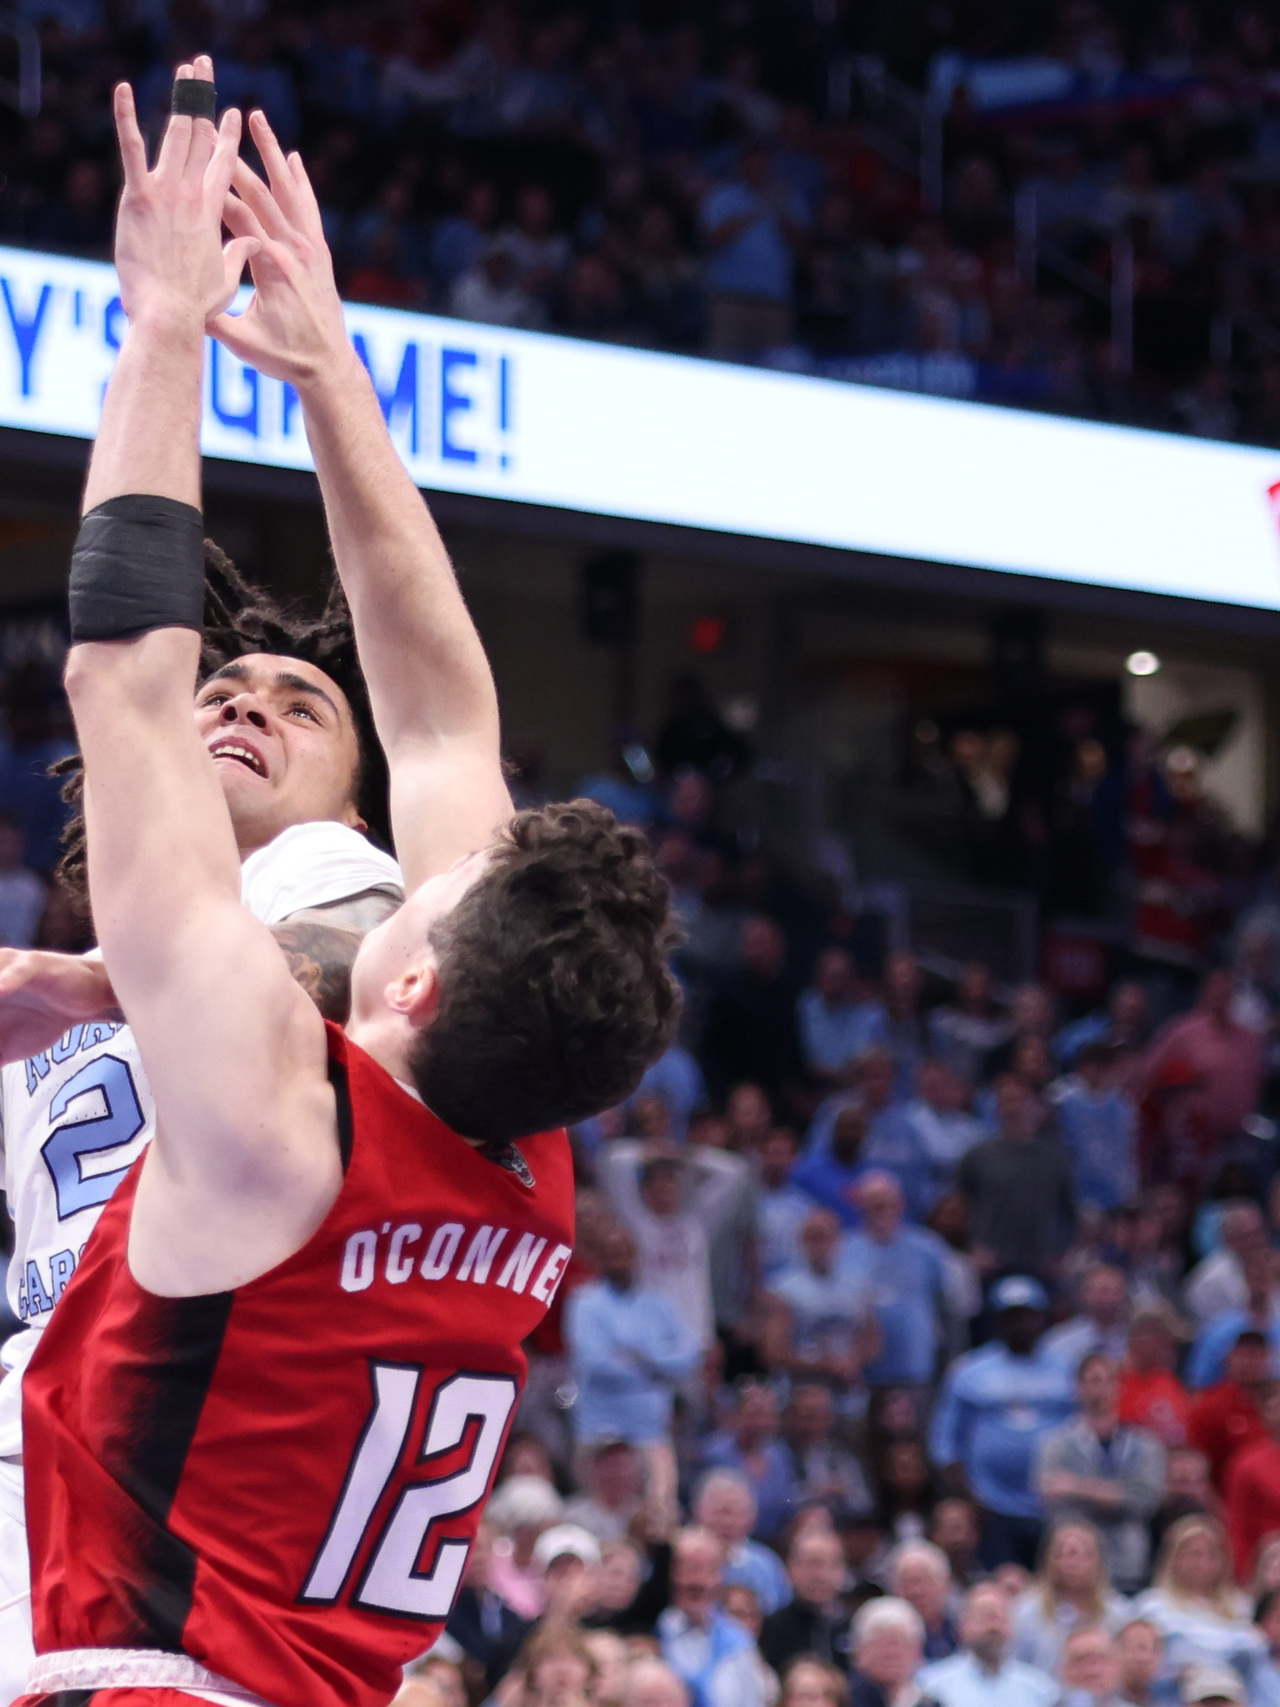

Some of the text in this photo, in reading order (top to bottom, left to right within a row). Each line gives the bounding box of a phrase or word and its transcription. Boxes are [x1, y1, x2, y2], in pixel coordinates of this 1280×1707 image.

[210, 309, 509, 470] GME!
[40, 1053, 146, 1222] 2
[19, 1243, 86, 1320] CAR
[339, 1221, 572, 1308] O'CONNE
[298, 1359, 518, 1622] 12
